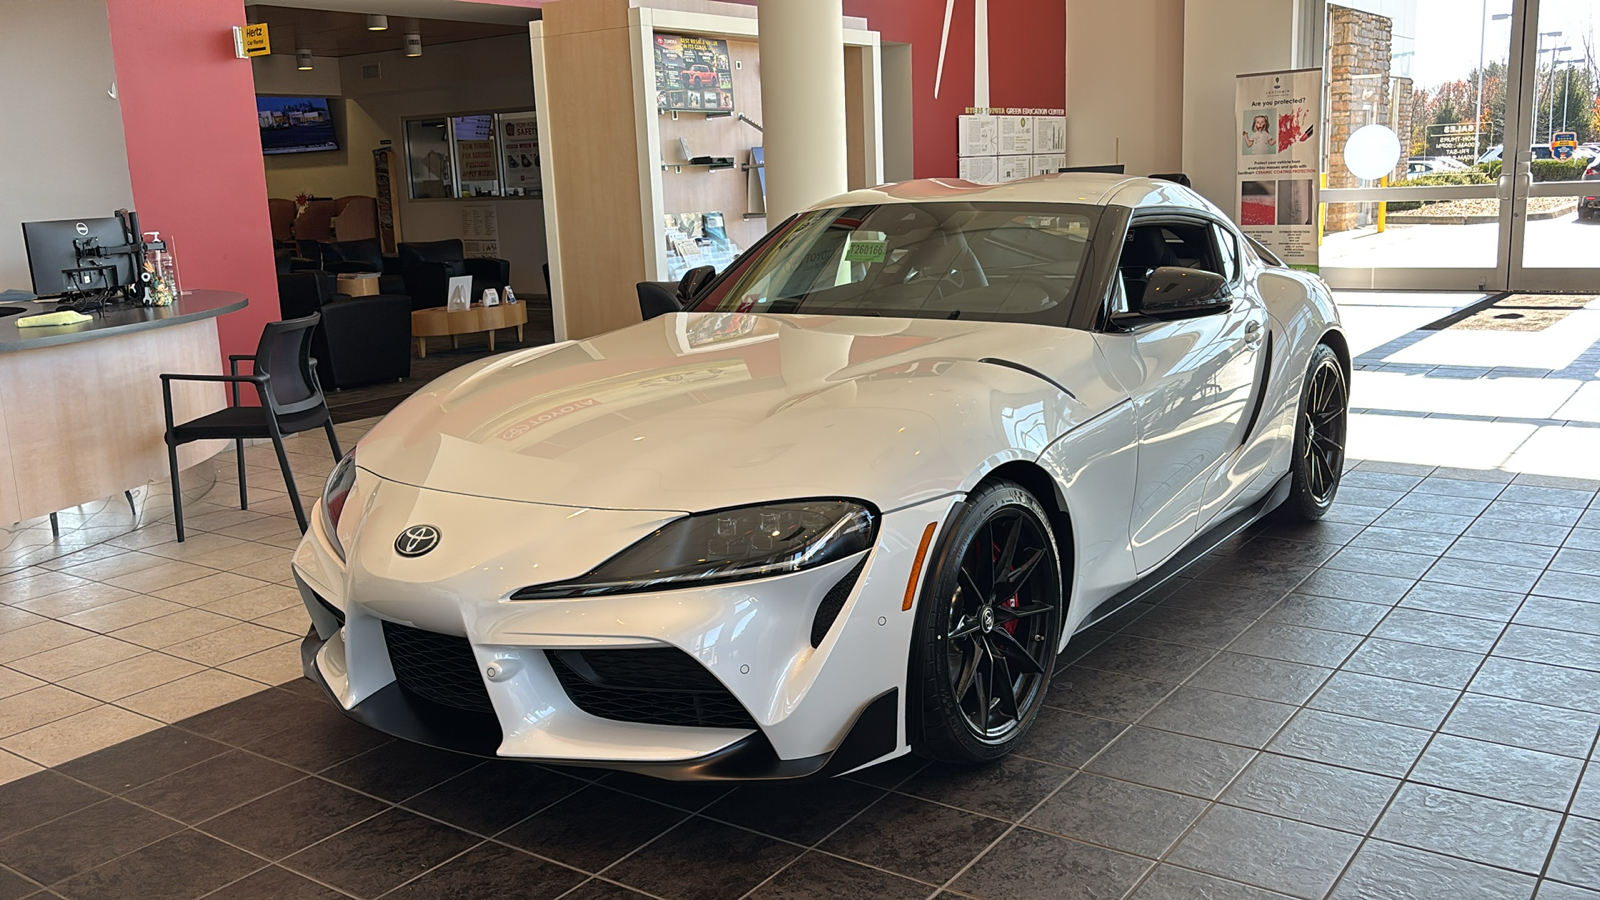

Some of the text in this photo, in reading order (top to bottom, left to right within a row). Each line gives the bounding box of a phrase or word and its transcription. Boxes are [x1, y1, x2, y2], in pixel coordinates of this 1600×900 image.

[246, 28, 262, 38] Hertz
[1274, 97, 1306, 106] protected?
[850, 245, 883, 255] T260166
